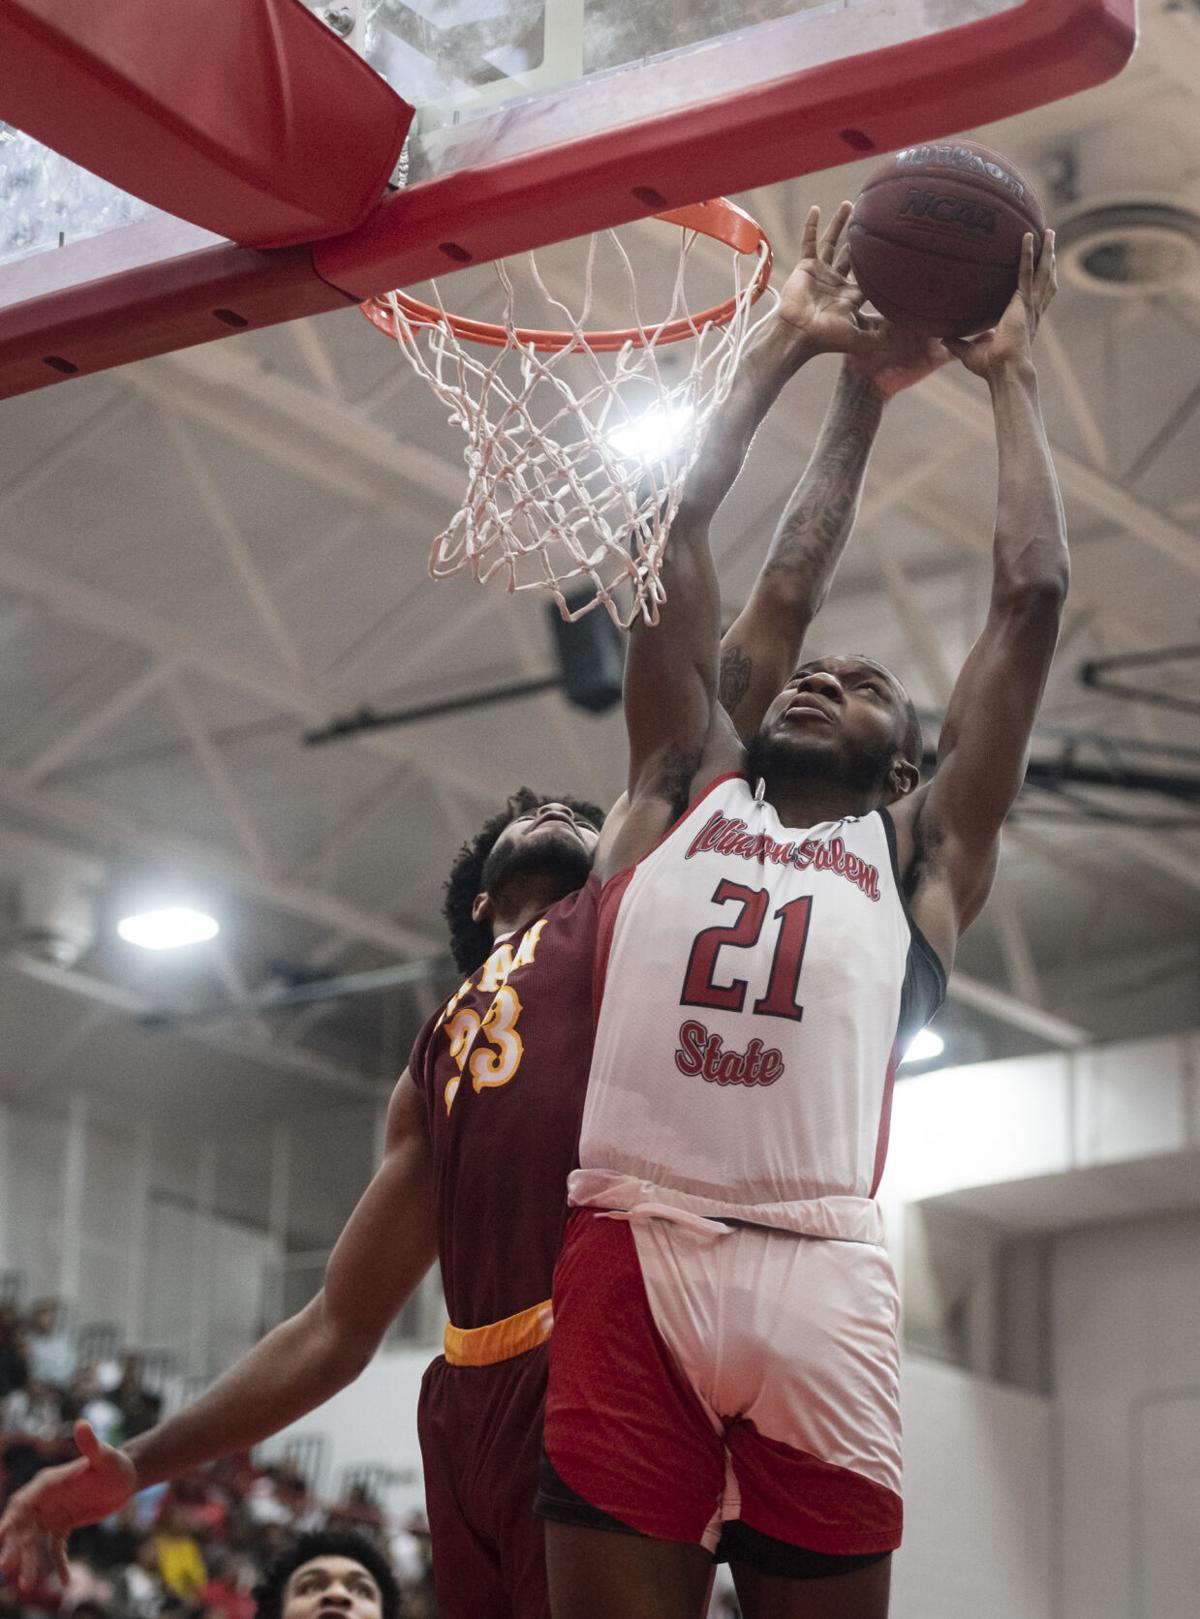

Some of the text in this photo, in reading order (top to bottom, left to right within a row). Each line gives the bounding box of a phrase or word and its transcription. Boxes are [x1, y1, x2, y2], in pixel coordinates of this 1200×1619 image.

[898, 187, 1001, 234] NCAA
[679, 877, 814, 1023] 21
[444, 985, 524, 1117] 23
[674, 1020, 785, 1088] State
